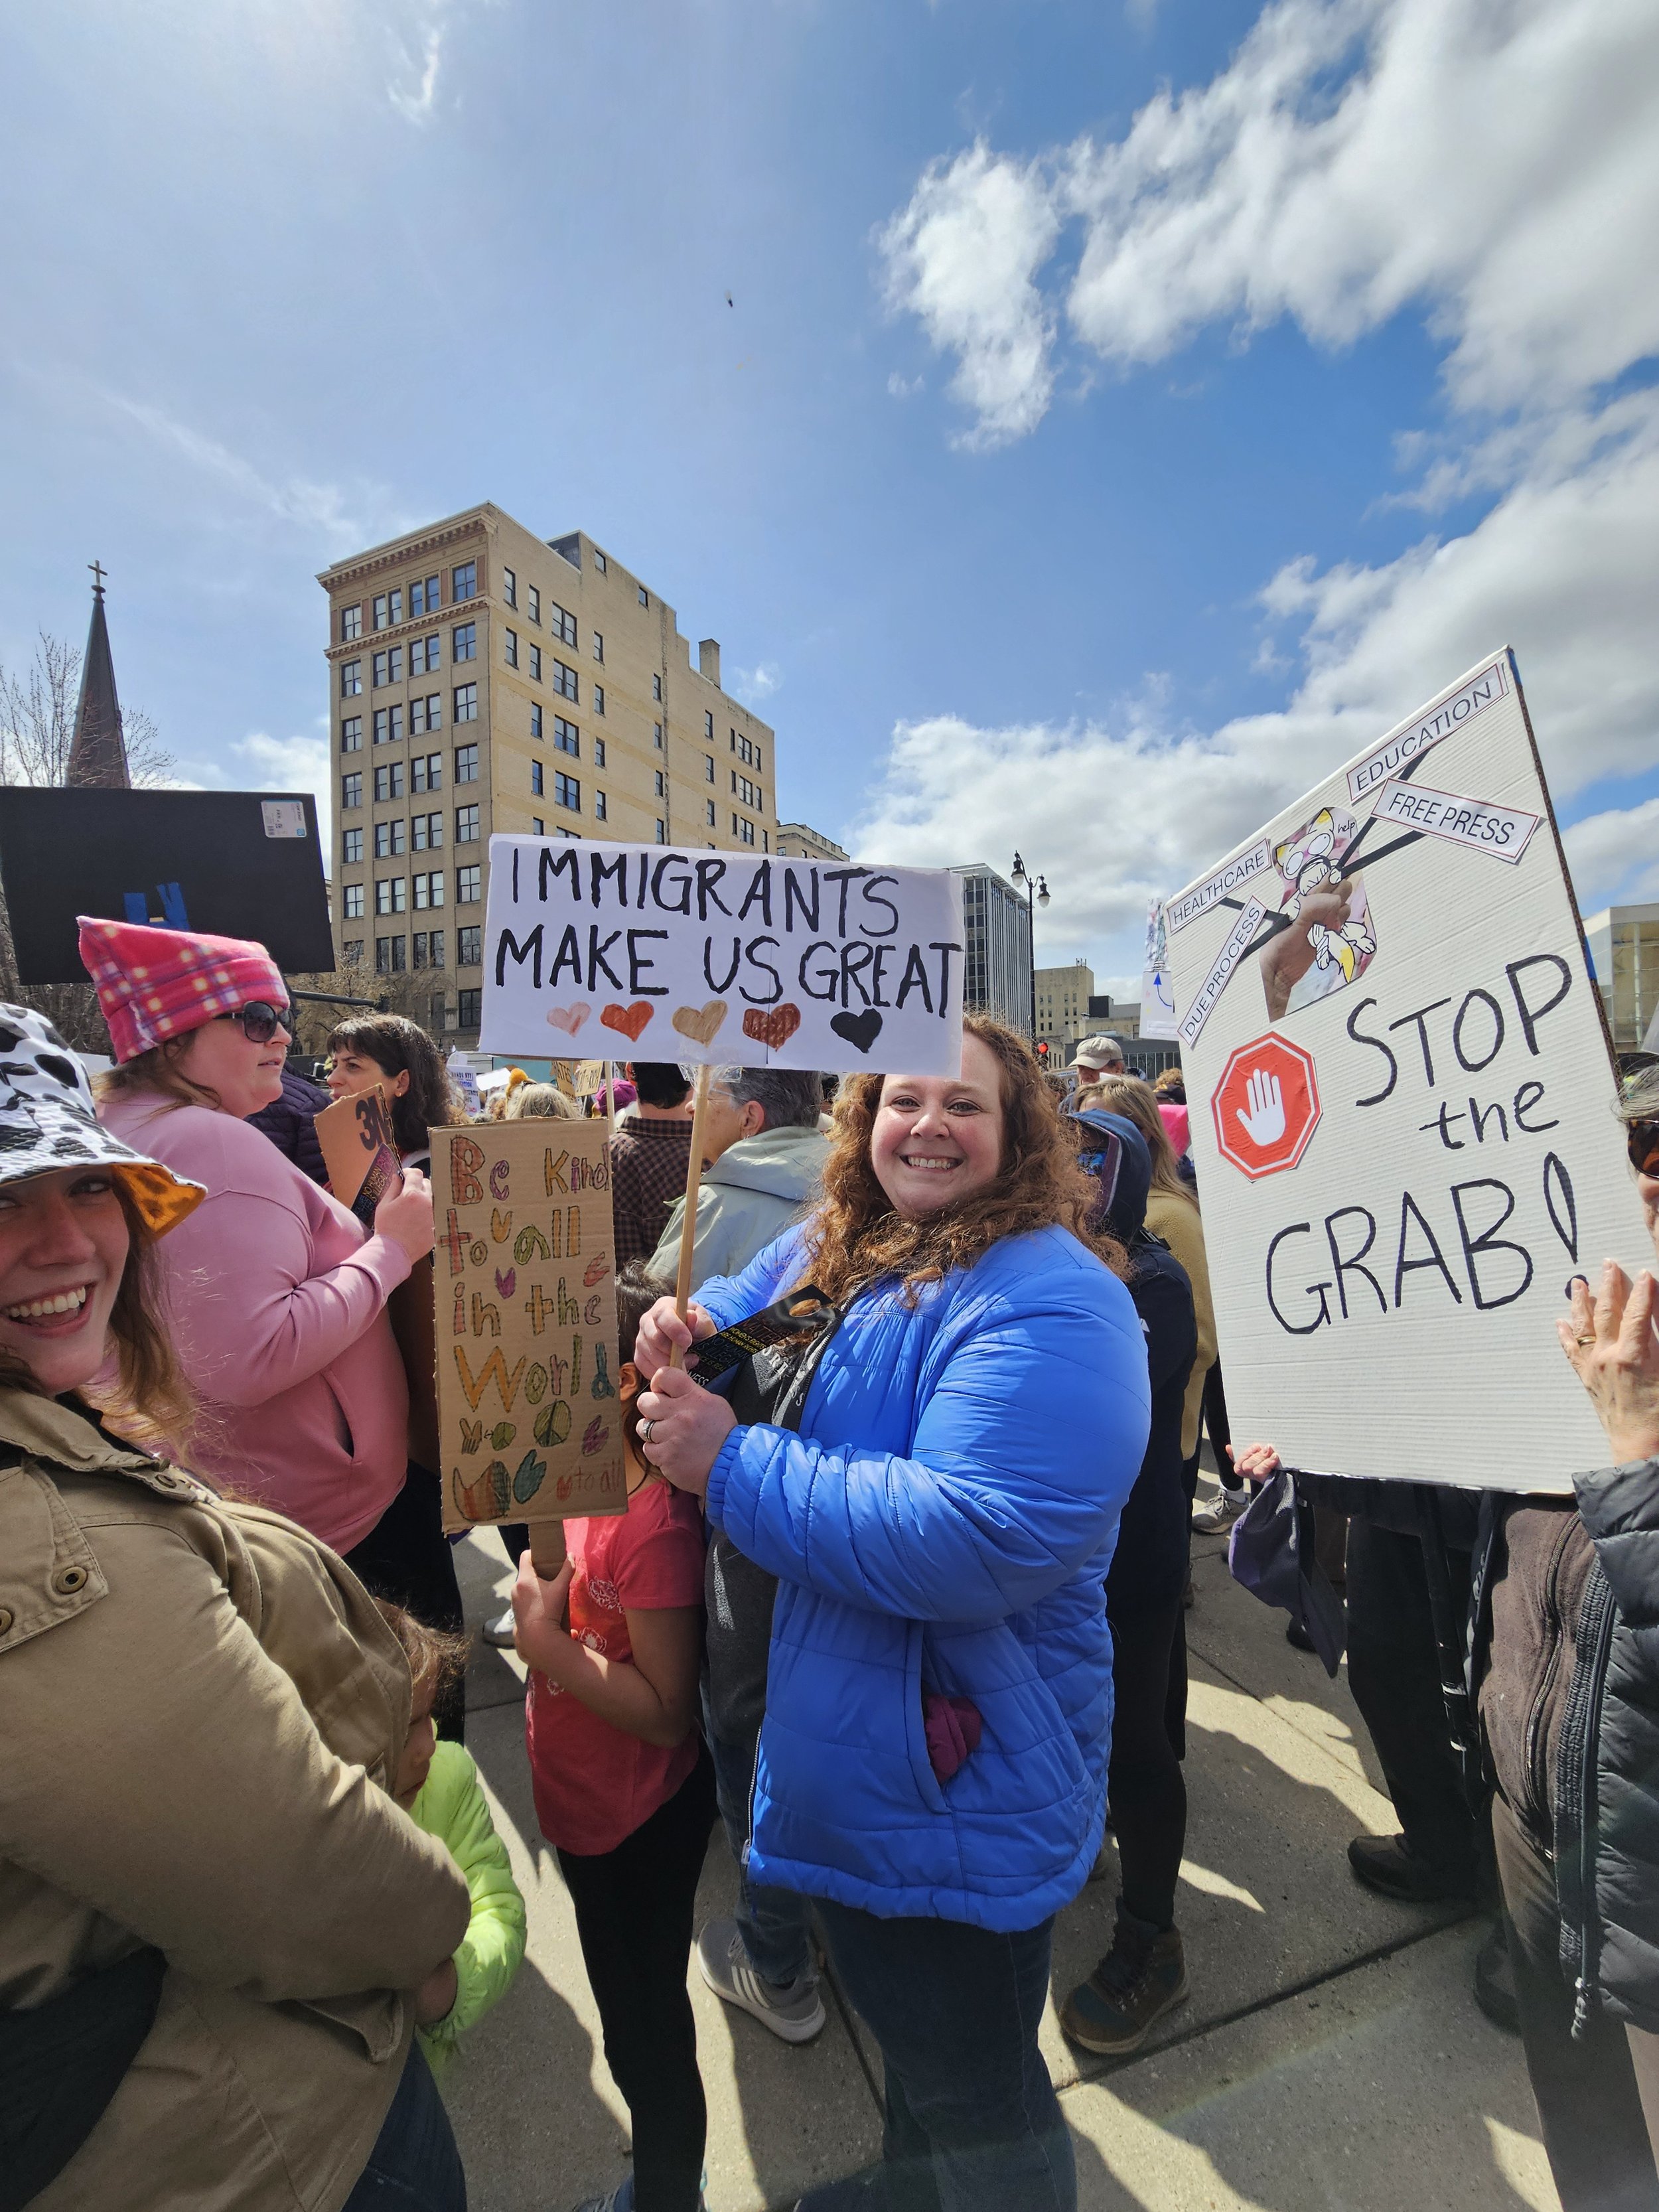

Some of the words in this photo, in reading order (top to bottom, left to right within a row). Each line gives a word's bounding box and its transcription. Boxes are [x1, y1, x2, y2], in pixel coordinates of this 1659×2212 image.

[1356, 680, 1492, 791] EDUCATION
[1338, 820, 1356, 839] help
[1388, 792, 1442, 825] FREE
[1441, 806, 1515, 846] PRESS
[512, 847, 900, 938] IMMIGRANTS
[1173, 849, 1265, 925] HEALTHCARE
[495, 924, 670, 995] MAKE
[703, 935, 784, 1005] US
[799, 940, 963, 1019] GREAT
[1185, 1000, 1210, 1037] DUE
[1207, 905, 1261, 999] PROCESS
[1346, 954, 1573, 1107] STOP
[1419, 1081, 1560, 1150] the
[450, 1135, 510, 1206] Be
[543, 1140, 611, 1197] Kind
[439, 1208, 488, 1278] to
[513, 1205, 581, 1265] all
[1266, 1151, 1590, 1335] GRAB!
[453, 1281, 502, 1337] in
[524, 1276, 602, 1337] the
[453, 1333, 616, 1414] World
